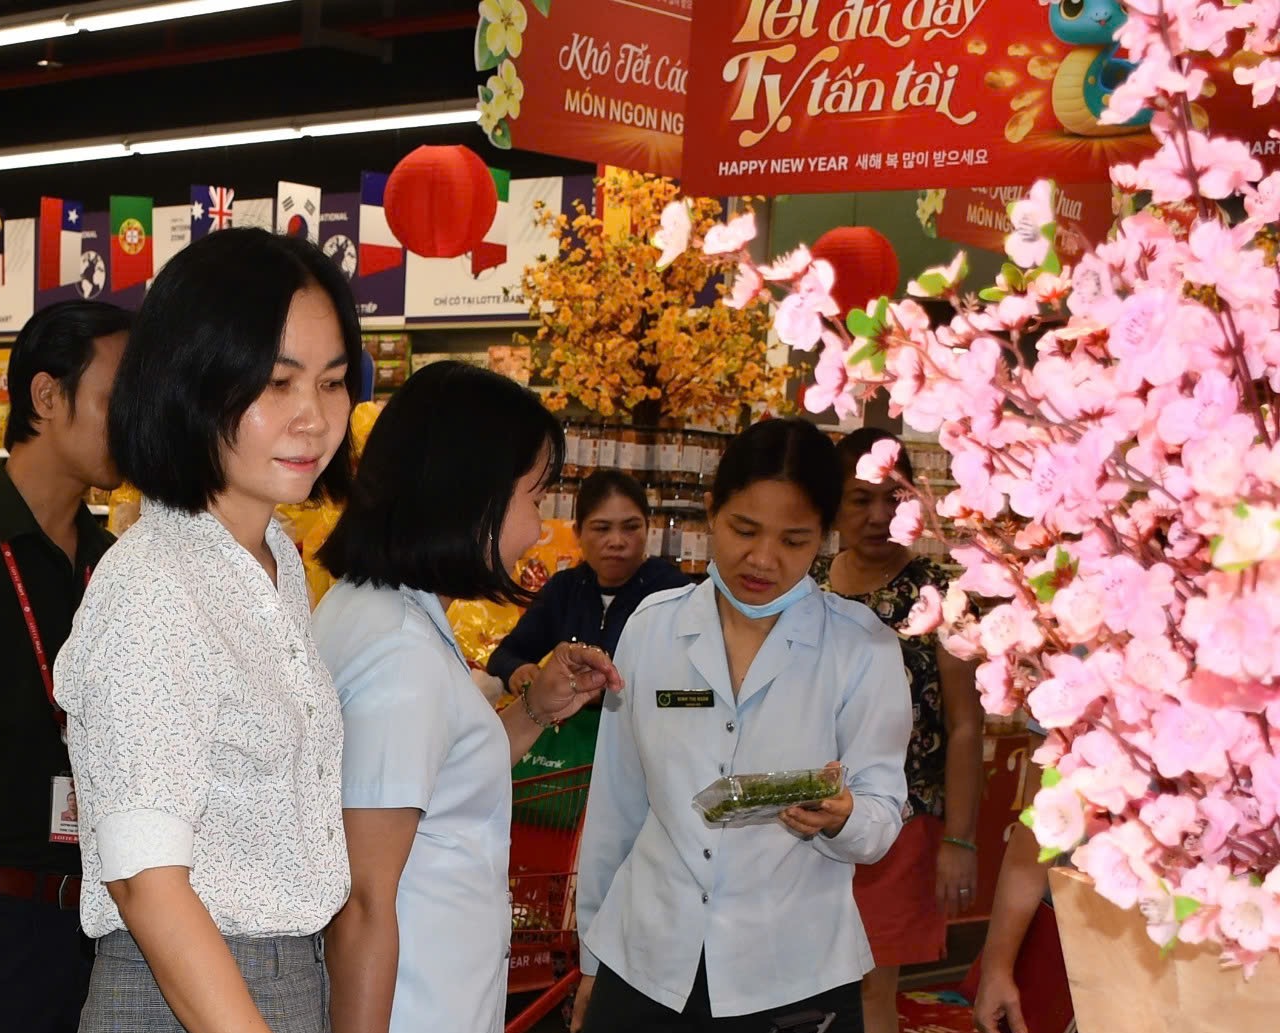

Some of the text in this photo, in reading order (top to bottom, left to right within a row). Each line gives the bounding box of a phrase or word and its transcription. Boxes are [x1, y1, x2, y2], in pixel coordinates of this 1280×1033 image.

[559, 33, 610, 80] Khô
[615, 43, 652, 86] Tết
[565, 86, 606, 118] MÓN
[609, 99, 659, 130] NGON
[807, 63, 885, 117] tấn
[891, 59, 977, 125] tài
[718, 156, 848, 177] HAPPY NEW YEAR
[855, 149, 988, 170] 새해 복 많이 받으세요
[967, 202, 993, 228] MÓN
